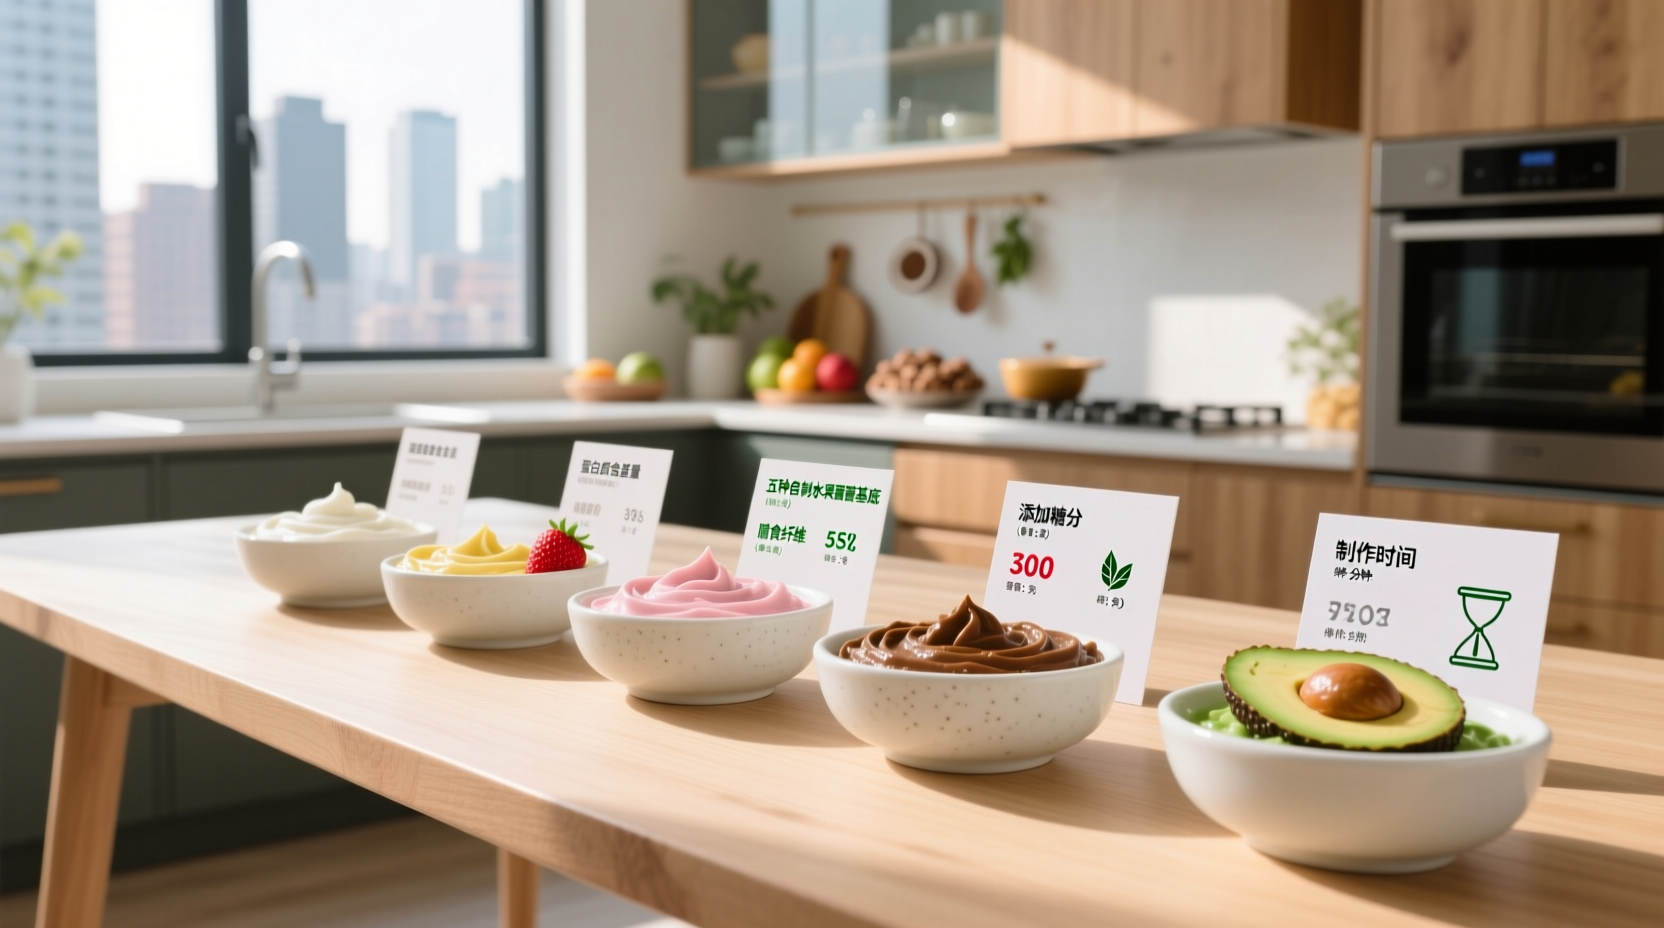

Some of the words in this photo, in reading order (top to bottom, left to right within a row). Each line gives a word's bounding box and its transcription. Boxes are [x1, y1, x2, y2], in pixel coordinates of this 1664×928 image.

[1009, 552, 1054, 580] 300
[1335, 539, 1417, 569] 制作时间
